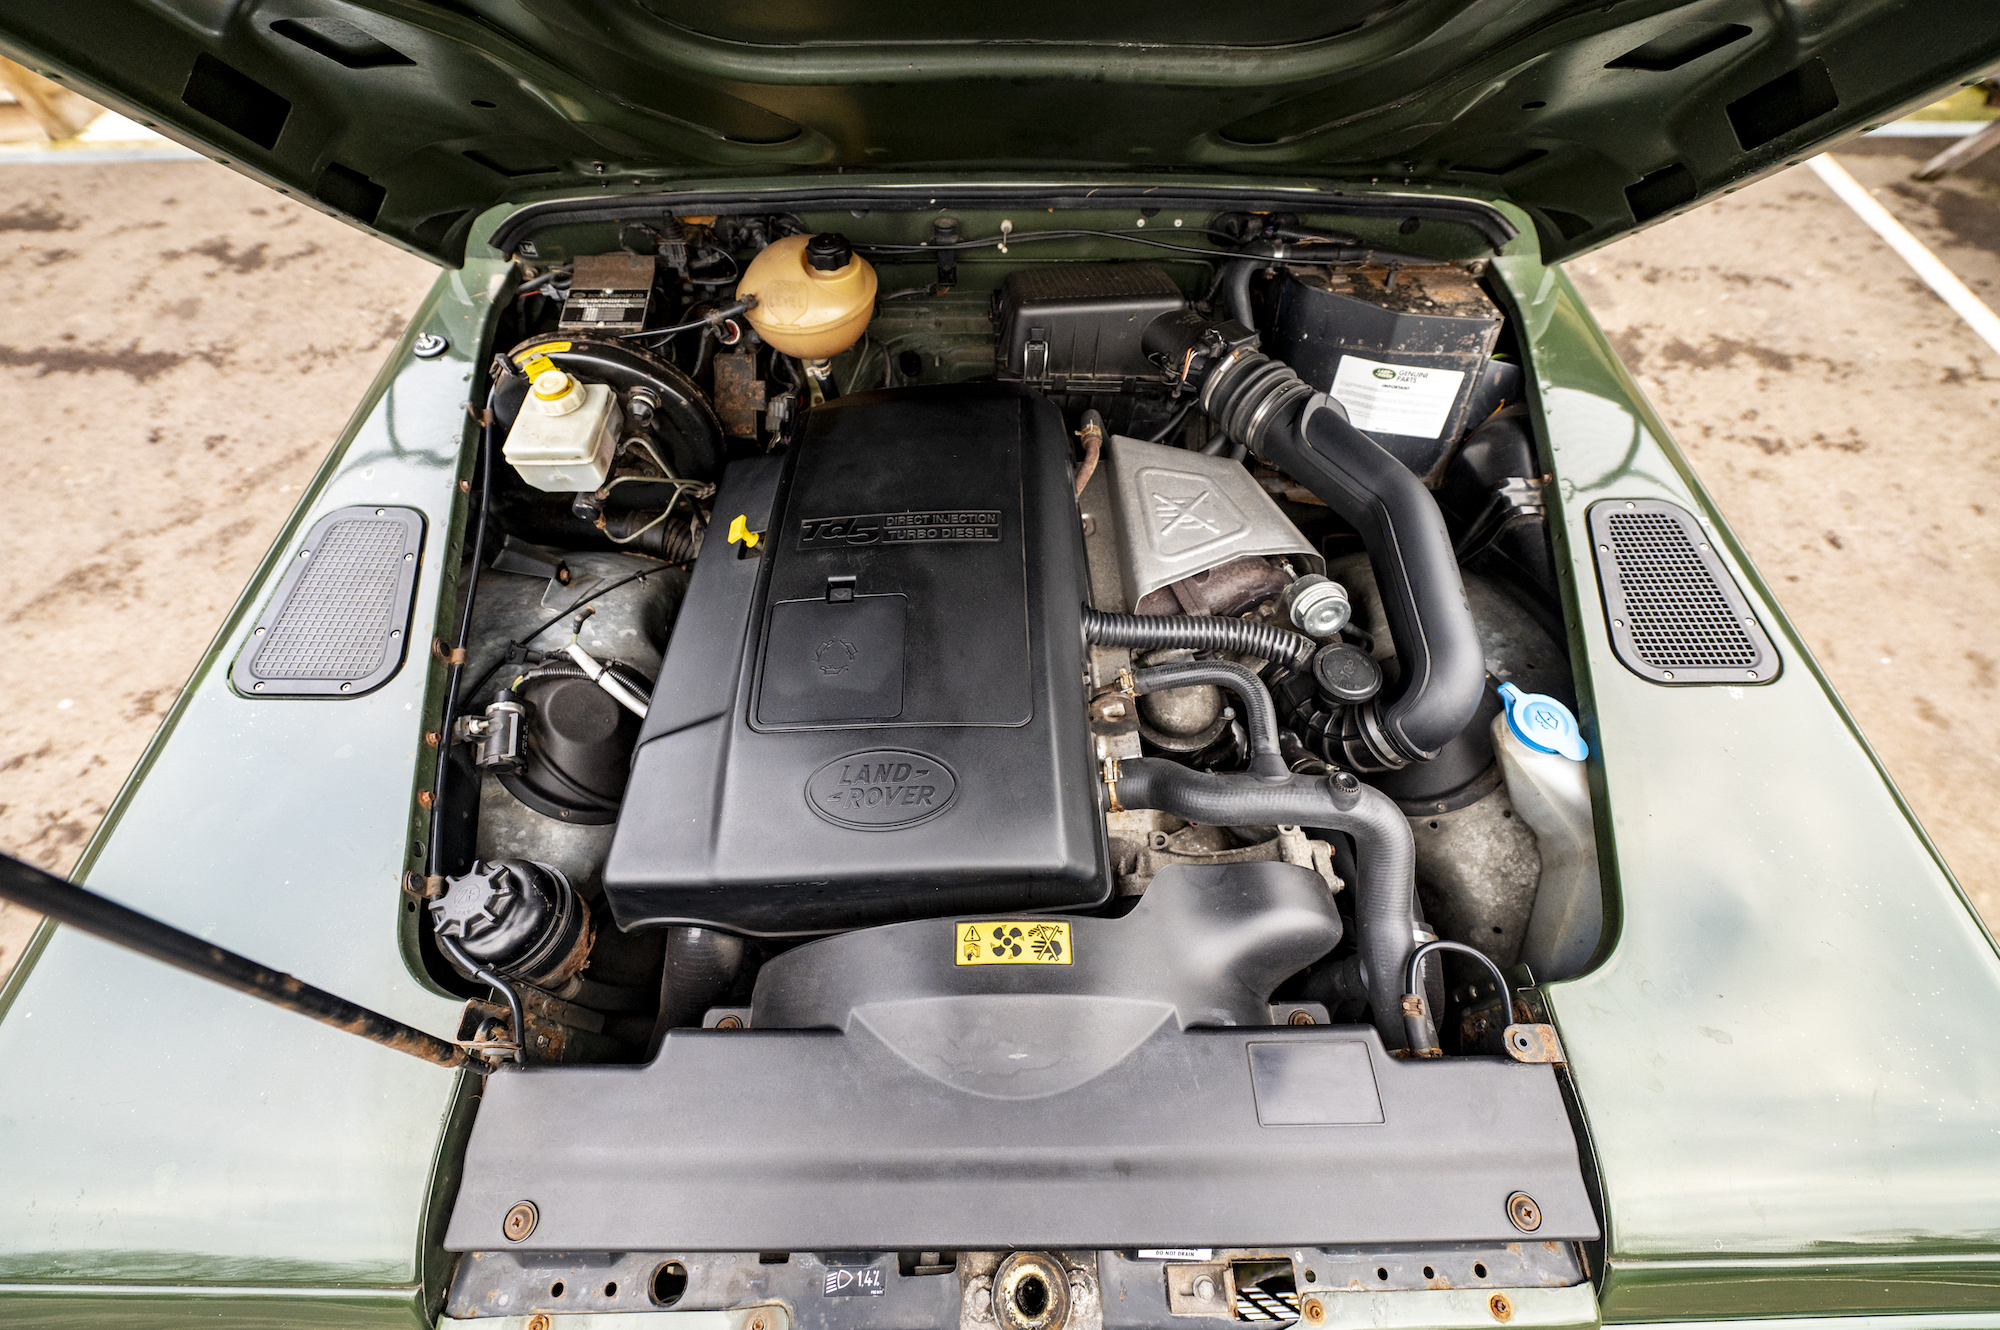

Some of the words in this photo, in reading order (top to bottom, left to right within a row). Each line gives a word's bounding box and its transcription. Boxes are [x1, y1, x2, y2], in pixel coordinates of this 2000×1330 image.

[1396, 376, 1417, 384] PARTS
[1399, 370, 1429, 379] GENUINE
[886, 514, 930, 527] DIRECT
[932, 513, 997, 525] INJECTION
[802, 517, 880, 545] Td5
[888, 527, 938, 540] TURBO
[941, 527, 993, 539] DIESEL
[837, 762, 913, 786] LAND
[842, 785, 936, 809] ROVER
